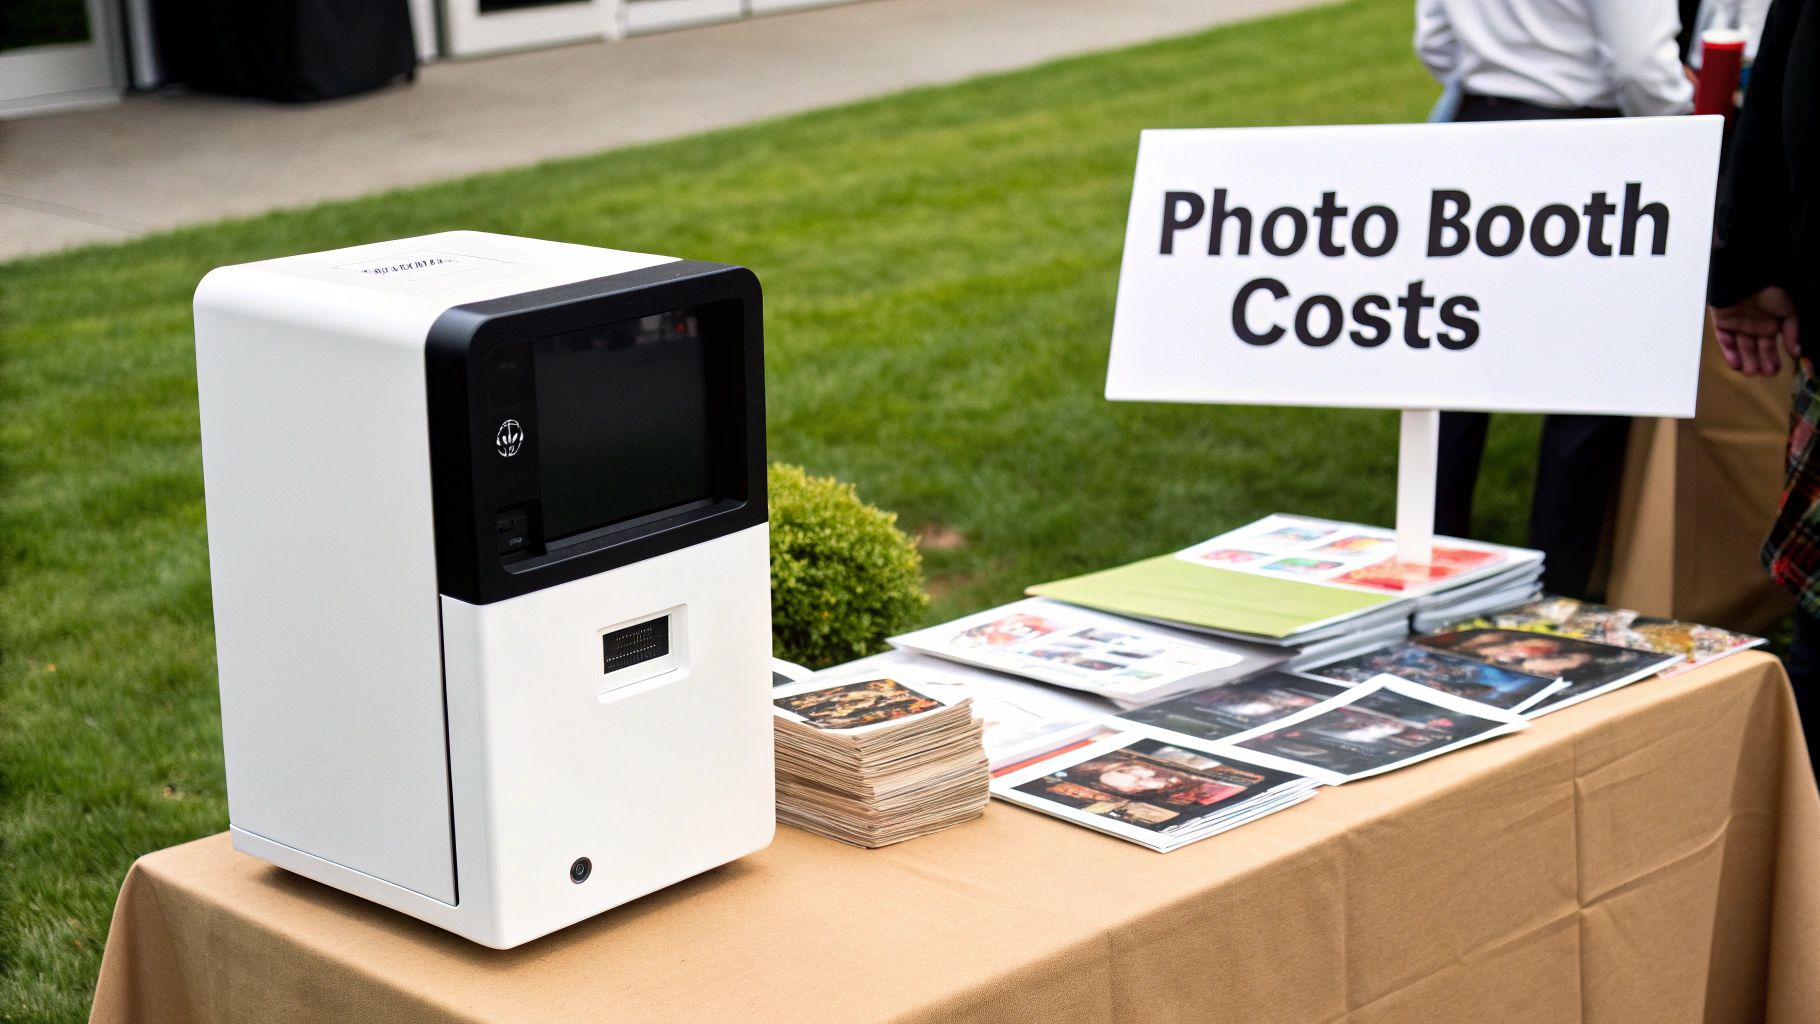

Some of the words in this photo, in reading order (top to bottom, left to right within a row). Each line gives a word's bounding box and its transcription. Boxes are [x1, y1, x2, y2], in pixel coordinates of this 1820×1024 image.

[1159, 187, 1399, 258] Photo
[1426, 182, 1670, 258] Booth
[1231, 277, 1480, 351] Costs
